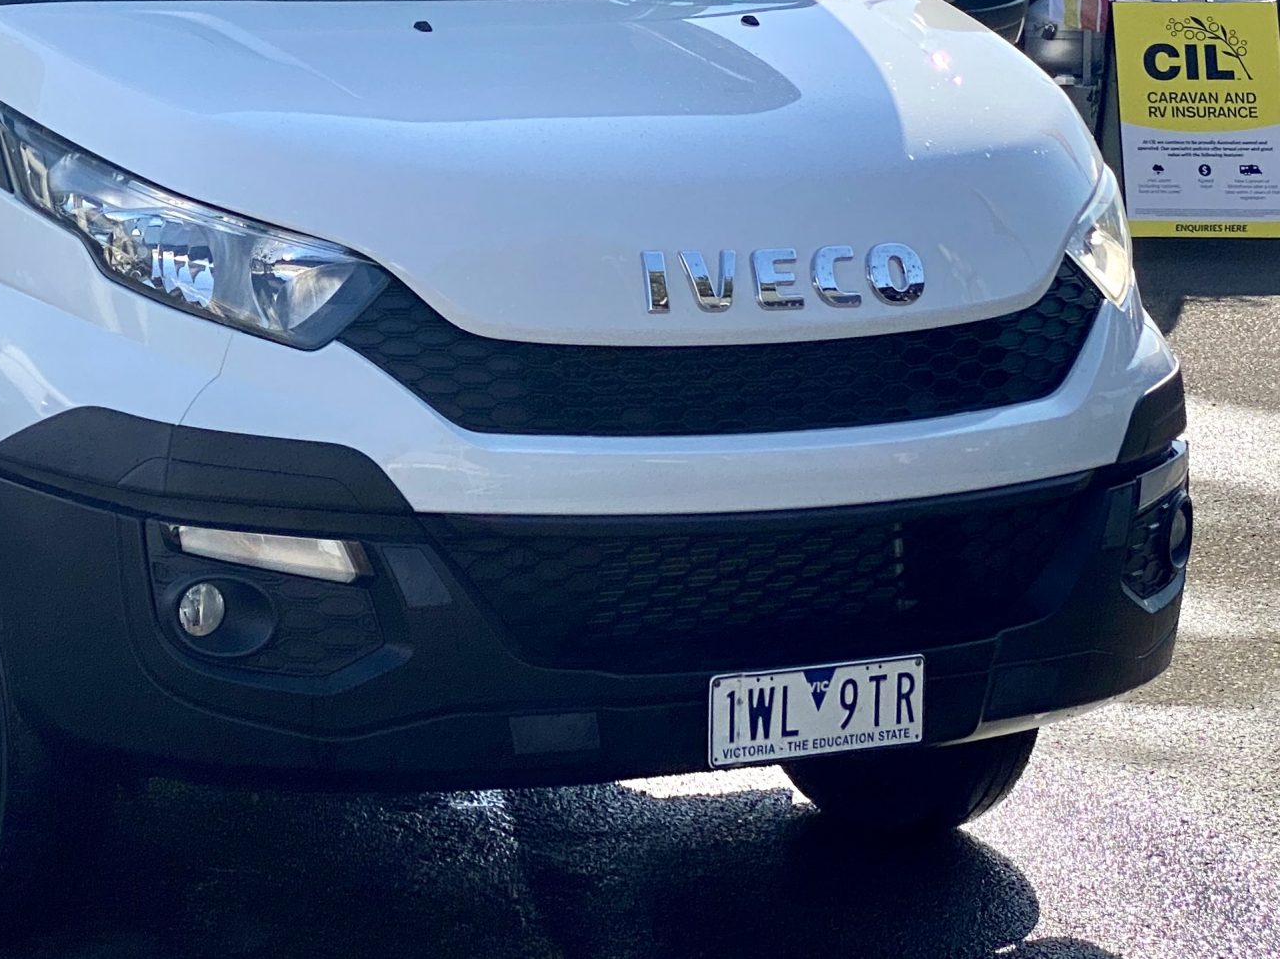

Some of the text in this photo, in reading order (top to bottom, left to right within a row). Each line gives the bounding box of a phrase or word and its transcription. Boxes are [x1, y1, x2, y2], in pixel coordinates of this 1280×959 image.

[1143, 43, 1236, 81] CIL
[1147, 91, 1257, 104] CARAVAN AND
[1148, 106, 1259, 119] RV INSURANCE
[1175, 224, 1248, 233] ENQUIRIES HERE
[640, 242, 925, 314] IVECO
[809, 680, 830, 693] VIC
[726, 671, 915, 743] 1WL 9TR
[722, 745, 776, 760] VICTORIA
[788, 740, 809, 752] THE
[811, 732, 876, 749] EDUCATION
[878, 727, 911, 742] STATE
